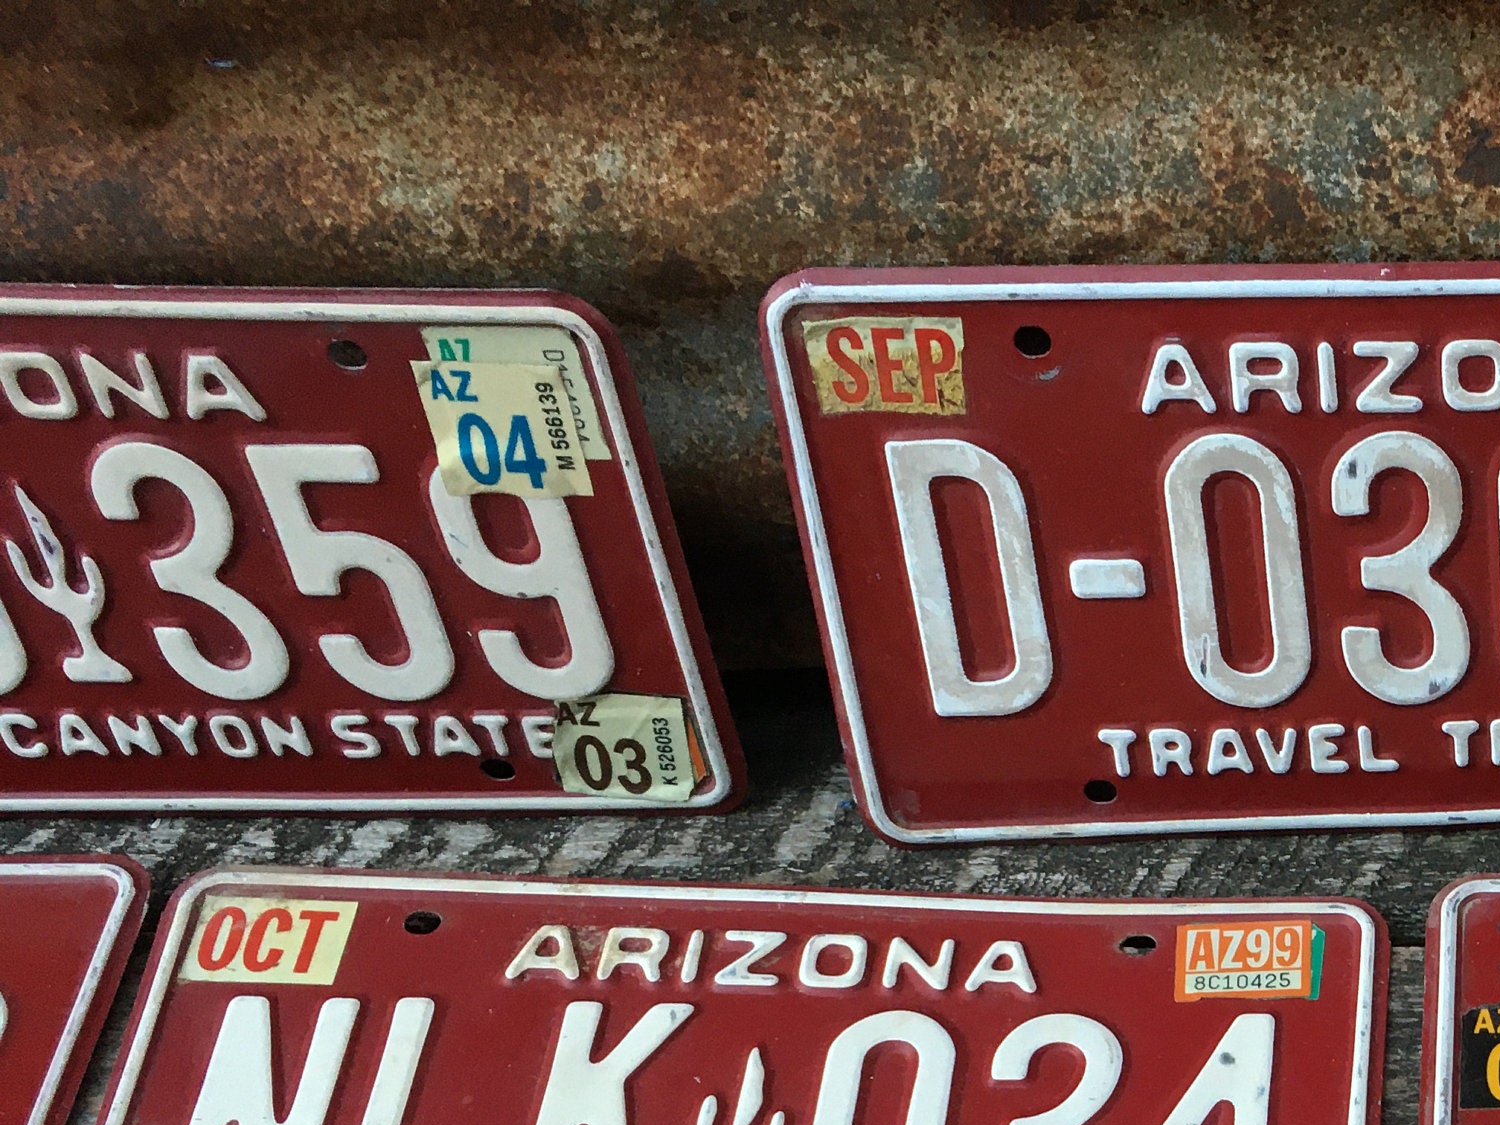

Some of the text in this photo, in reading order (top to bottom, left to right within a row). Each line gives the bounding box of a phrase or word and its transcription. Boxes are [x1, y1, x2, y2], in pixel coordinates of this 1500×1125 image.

[430, 369, 479, 402] AZ
[824, 326, 957, 406] SEP
[534, 382, 570, 451] 566139
[457, 412, 547, 489] 04
[0, 713, 554, 760] CANYON STATE
[556, 702, 600, 727] AZ
[574, 735, 652, 794] 03
[652, 717, 676, 771] 526053
[1098, 723, 1400, 778] TRAVEL
[197, 906, 340, 975] OCT
[504, 924, 1037, 994] ARIZONA
[1194, 972, 1291, 990] 8C10425
